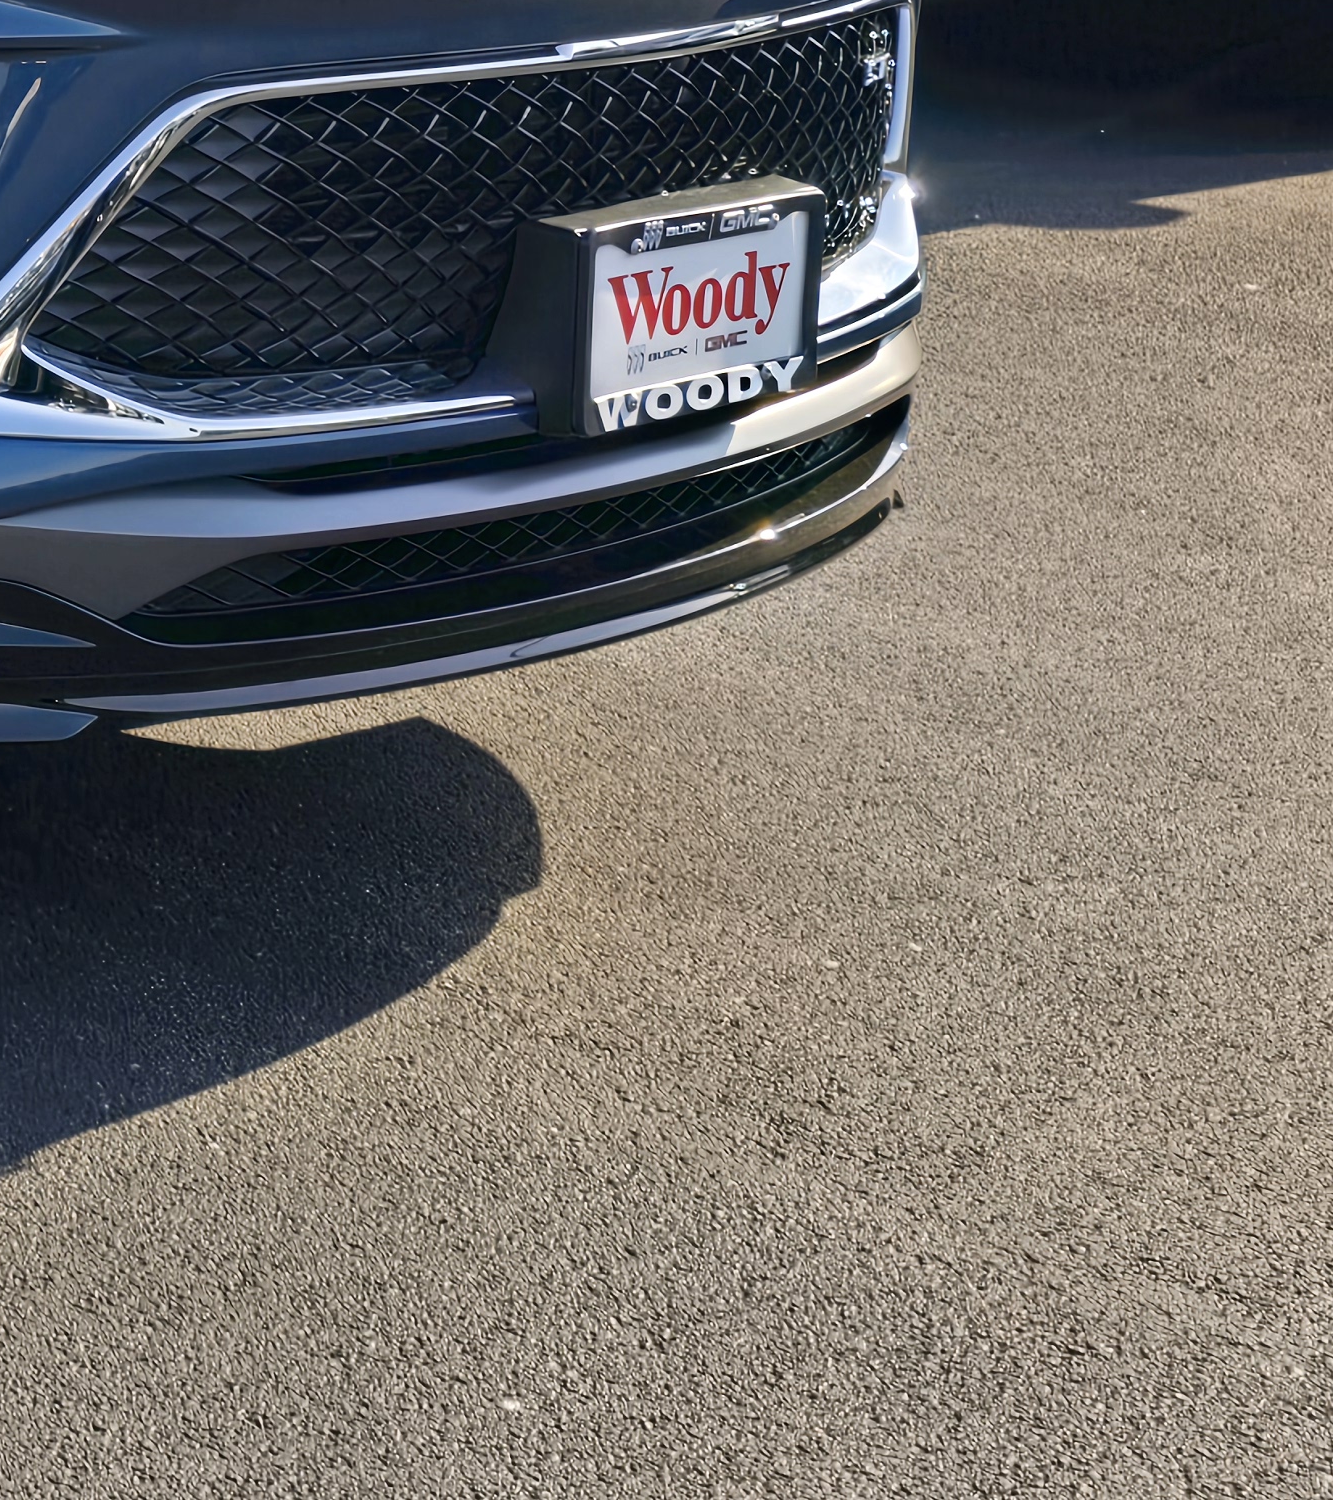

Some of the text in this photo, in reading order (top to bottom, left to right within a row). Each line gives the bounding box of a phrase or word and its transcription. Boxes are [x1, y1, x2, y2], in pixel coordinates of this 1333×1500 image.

[665, 204, 775, 237] BUICK GMC
[608, 250, 791, 345] Woody
[648, 330, 748, 362] BUICK GMC
[594, 355, 805, 432] WOODY
